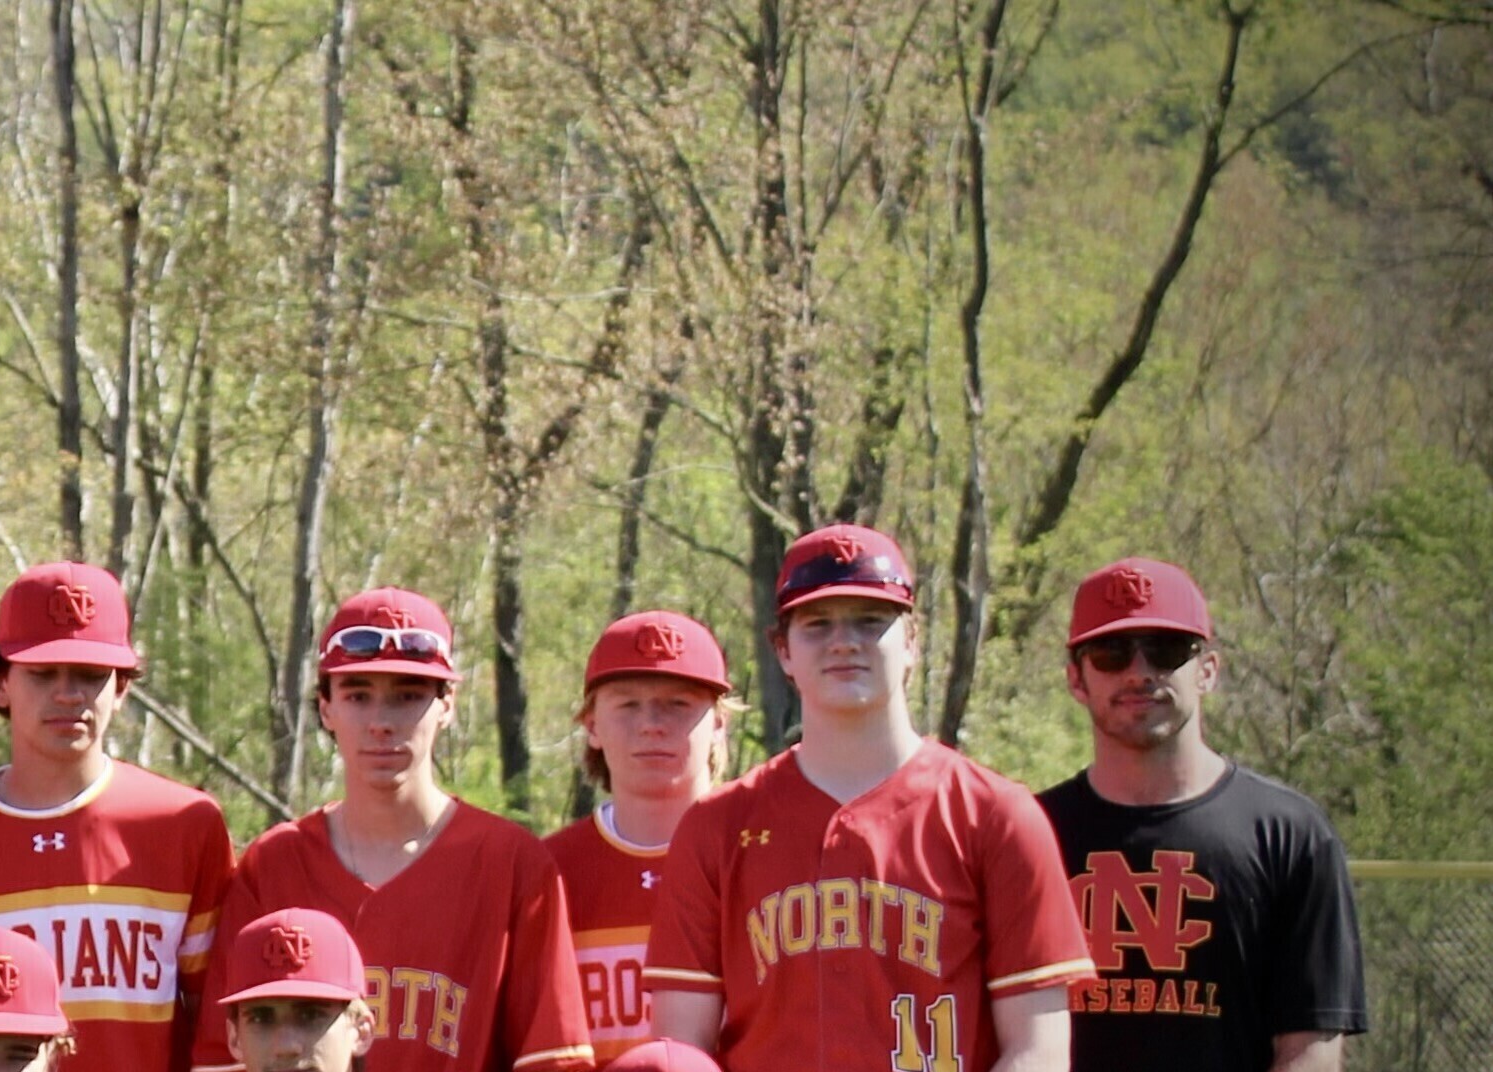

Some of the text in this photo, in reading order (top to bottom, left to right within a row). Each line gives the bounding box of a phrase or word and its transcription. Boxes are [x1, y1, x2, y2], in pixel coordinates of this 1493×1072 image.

[746, 877, 944, 985] NORTH
[364, 965, 467, 1057] RTH
[1068, 978, 1221, 1018] ASEBALL
